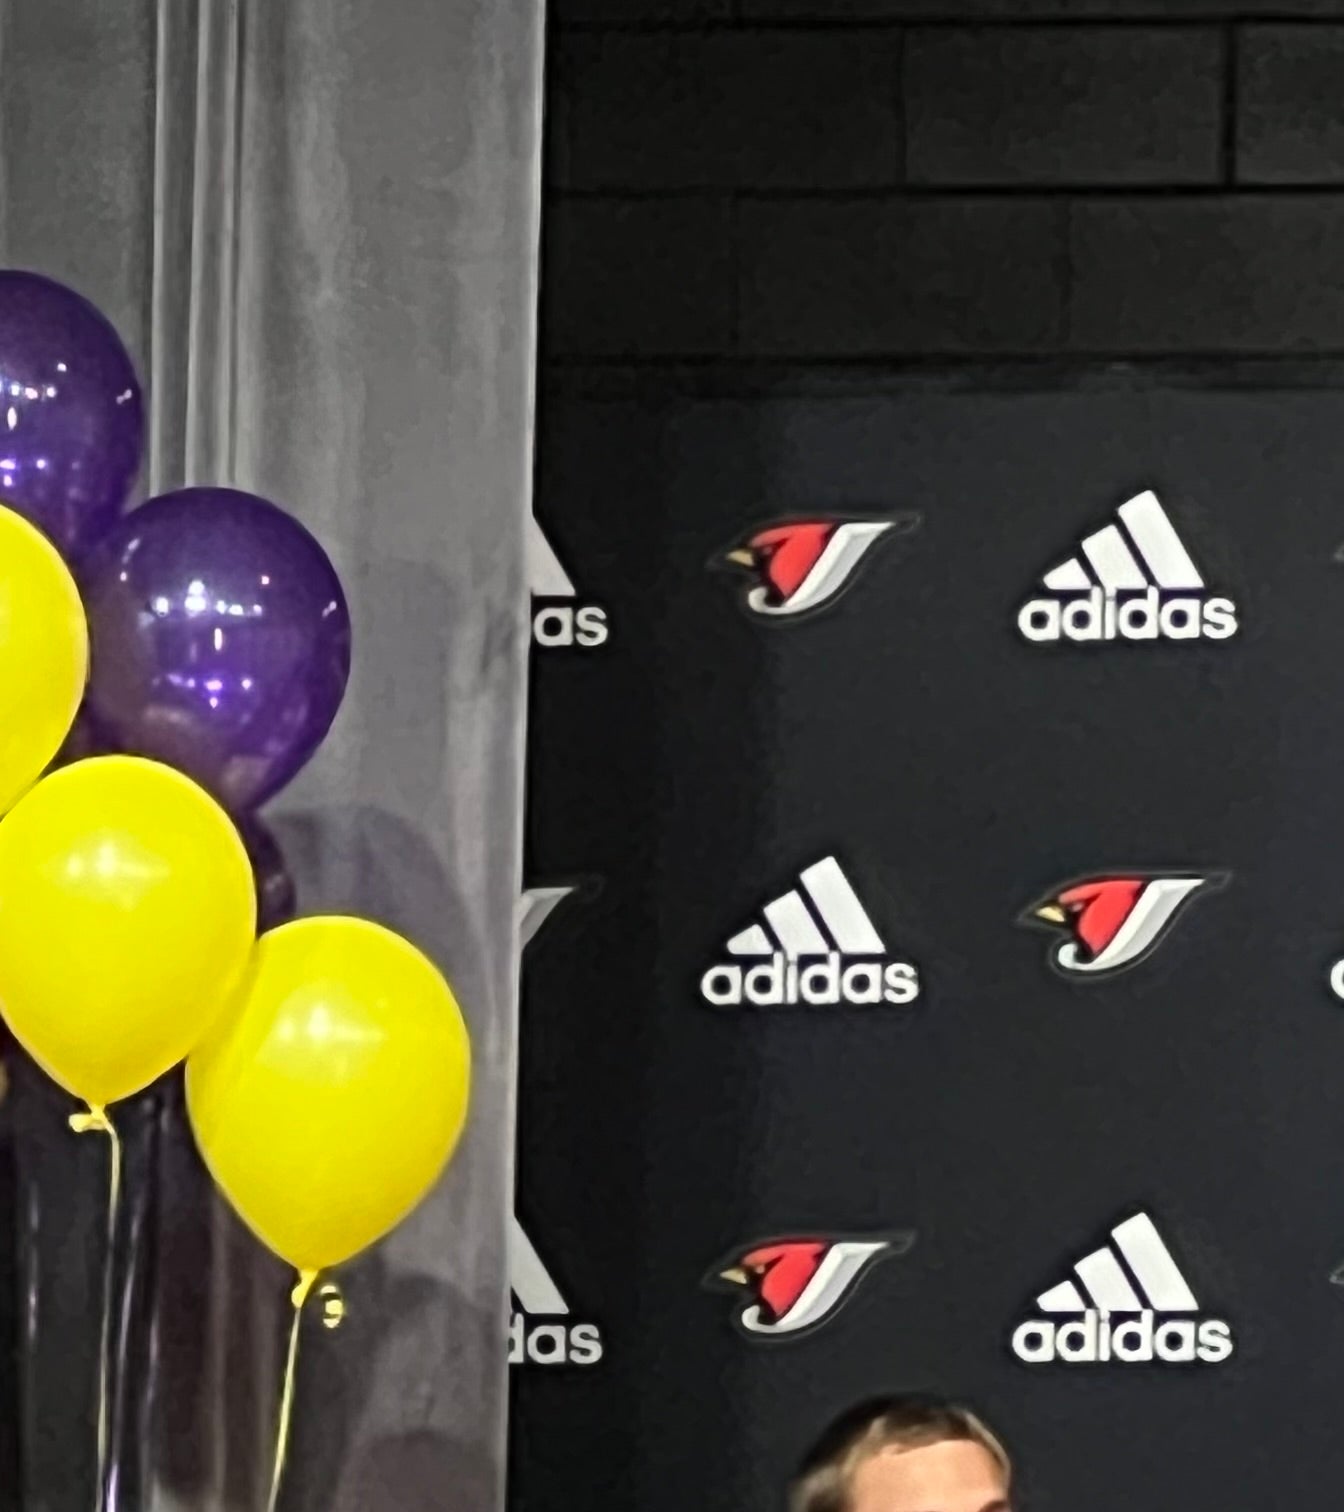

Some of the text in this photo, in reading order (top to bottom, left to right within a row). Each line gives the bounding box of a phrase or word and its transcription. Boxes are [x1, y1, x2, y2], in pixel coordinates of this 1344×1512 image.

[1018, 587, 1238, 641] adidas
[701, 951, 918, 1005] adidas
[1012, 1309, 1233, 1363] adidas
